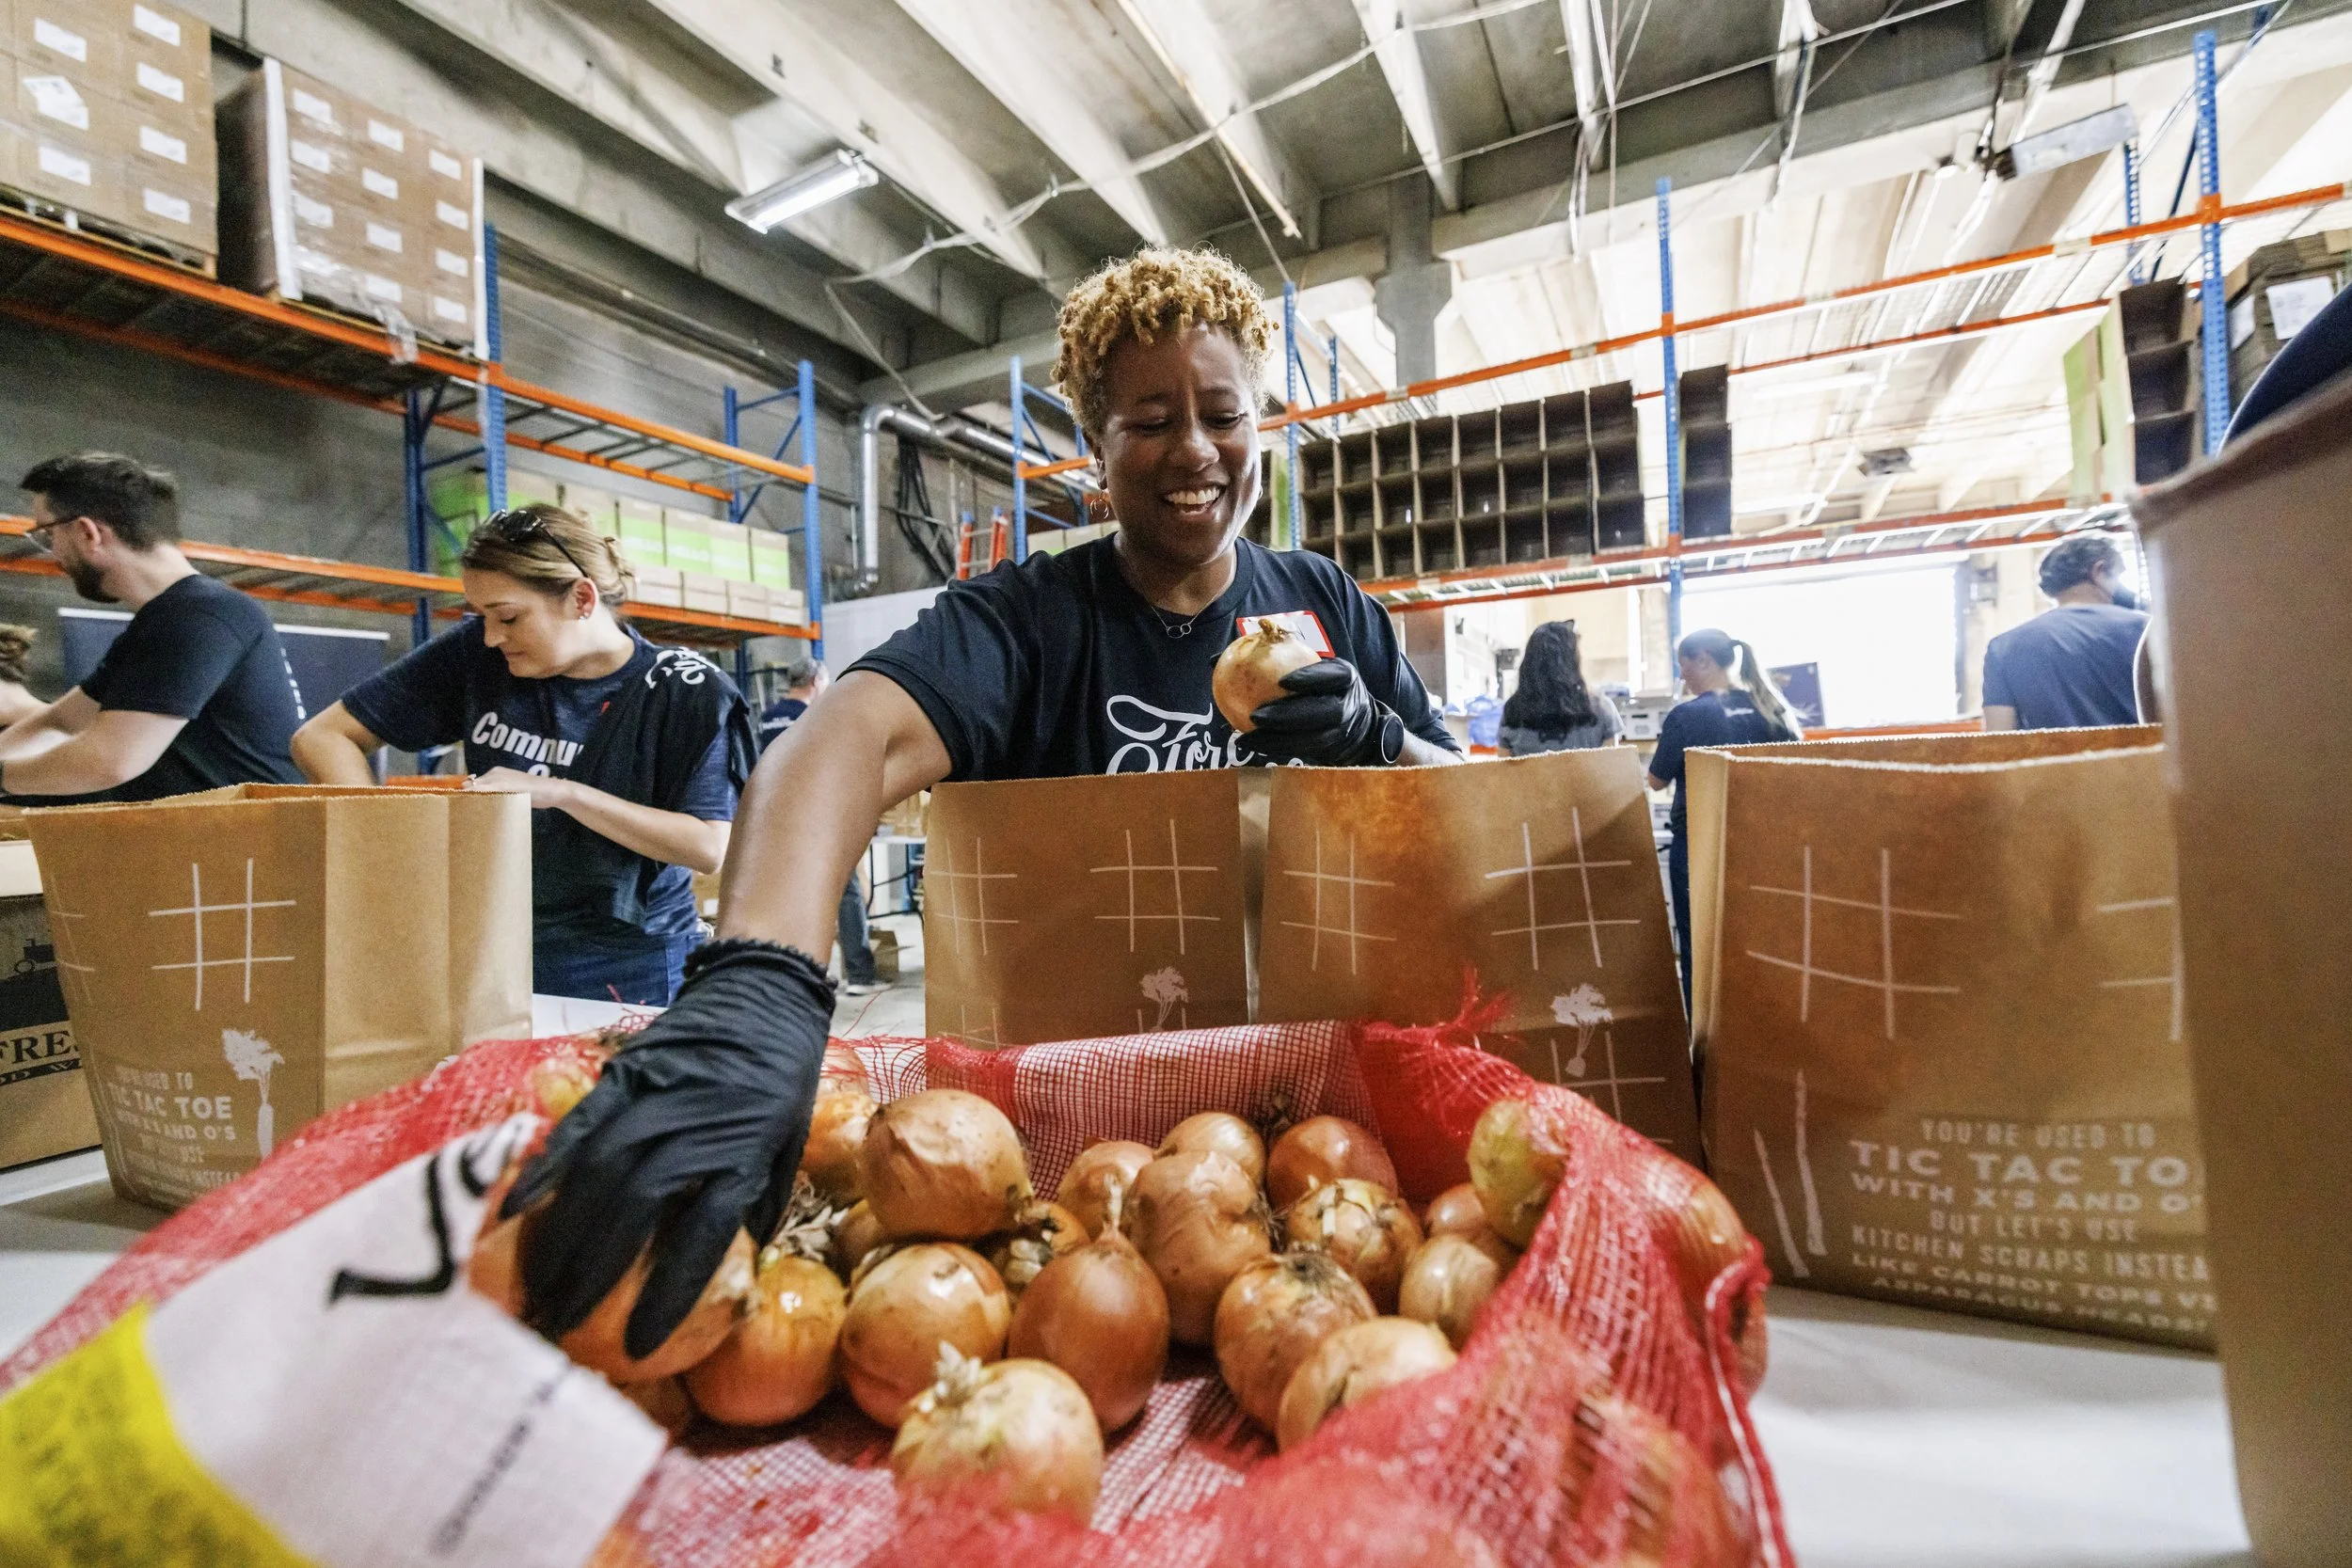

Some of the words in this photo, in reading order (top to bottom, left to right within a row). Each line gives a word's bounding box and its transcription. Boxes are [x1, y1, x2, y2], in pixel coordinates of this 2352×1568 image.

[174, 1095, 233, 1120] TOE
[203, 1125, 236, 1141] O'S
[1921, 1117, 2019, 1148] YOU'RE
[2036, 1123, 2106, 1150] USED
[2121, 1122, 2155, 1149] TO
[1849, 1139, 1943, 1176] TIC
[1967, 1152, 2084, 1186] TAC
[2108, 1155, 2189, 1188] TO
[1851, 1172, 1955, 1205] WITH
[1975, 1187, 2036, 1211] X'S
[2055, 1192, 2142, 1212] AND
[2159, 1193, 2202, 1214] O'
[1930, 1209, 1980, 1237] BUT
[1996, 1213, 2072, 1241] LET'S
[2085, 1217, 2136, 1243] USE
[1852, 1225, 1964, 1259] KITCHEN
[1979, 1244, 2089, 1274] SCRAPS
[2104, 1251, 2210, 1281] INSTEA
[1852, 1253, 1918, 1275] LIKE
